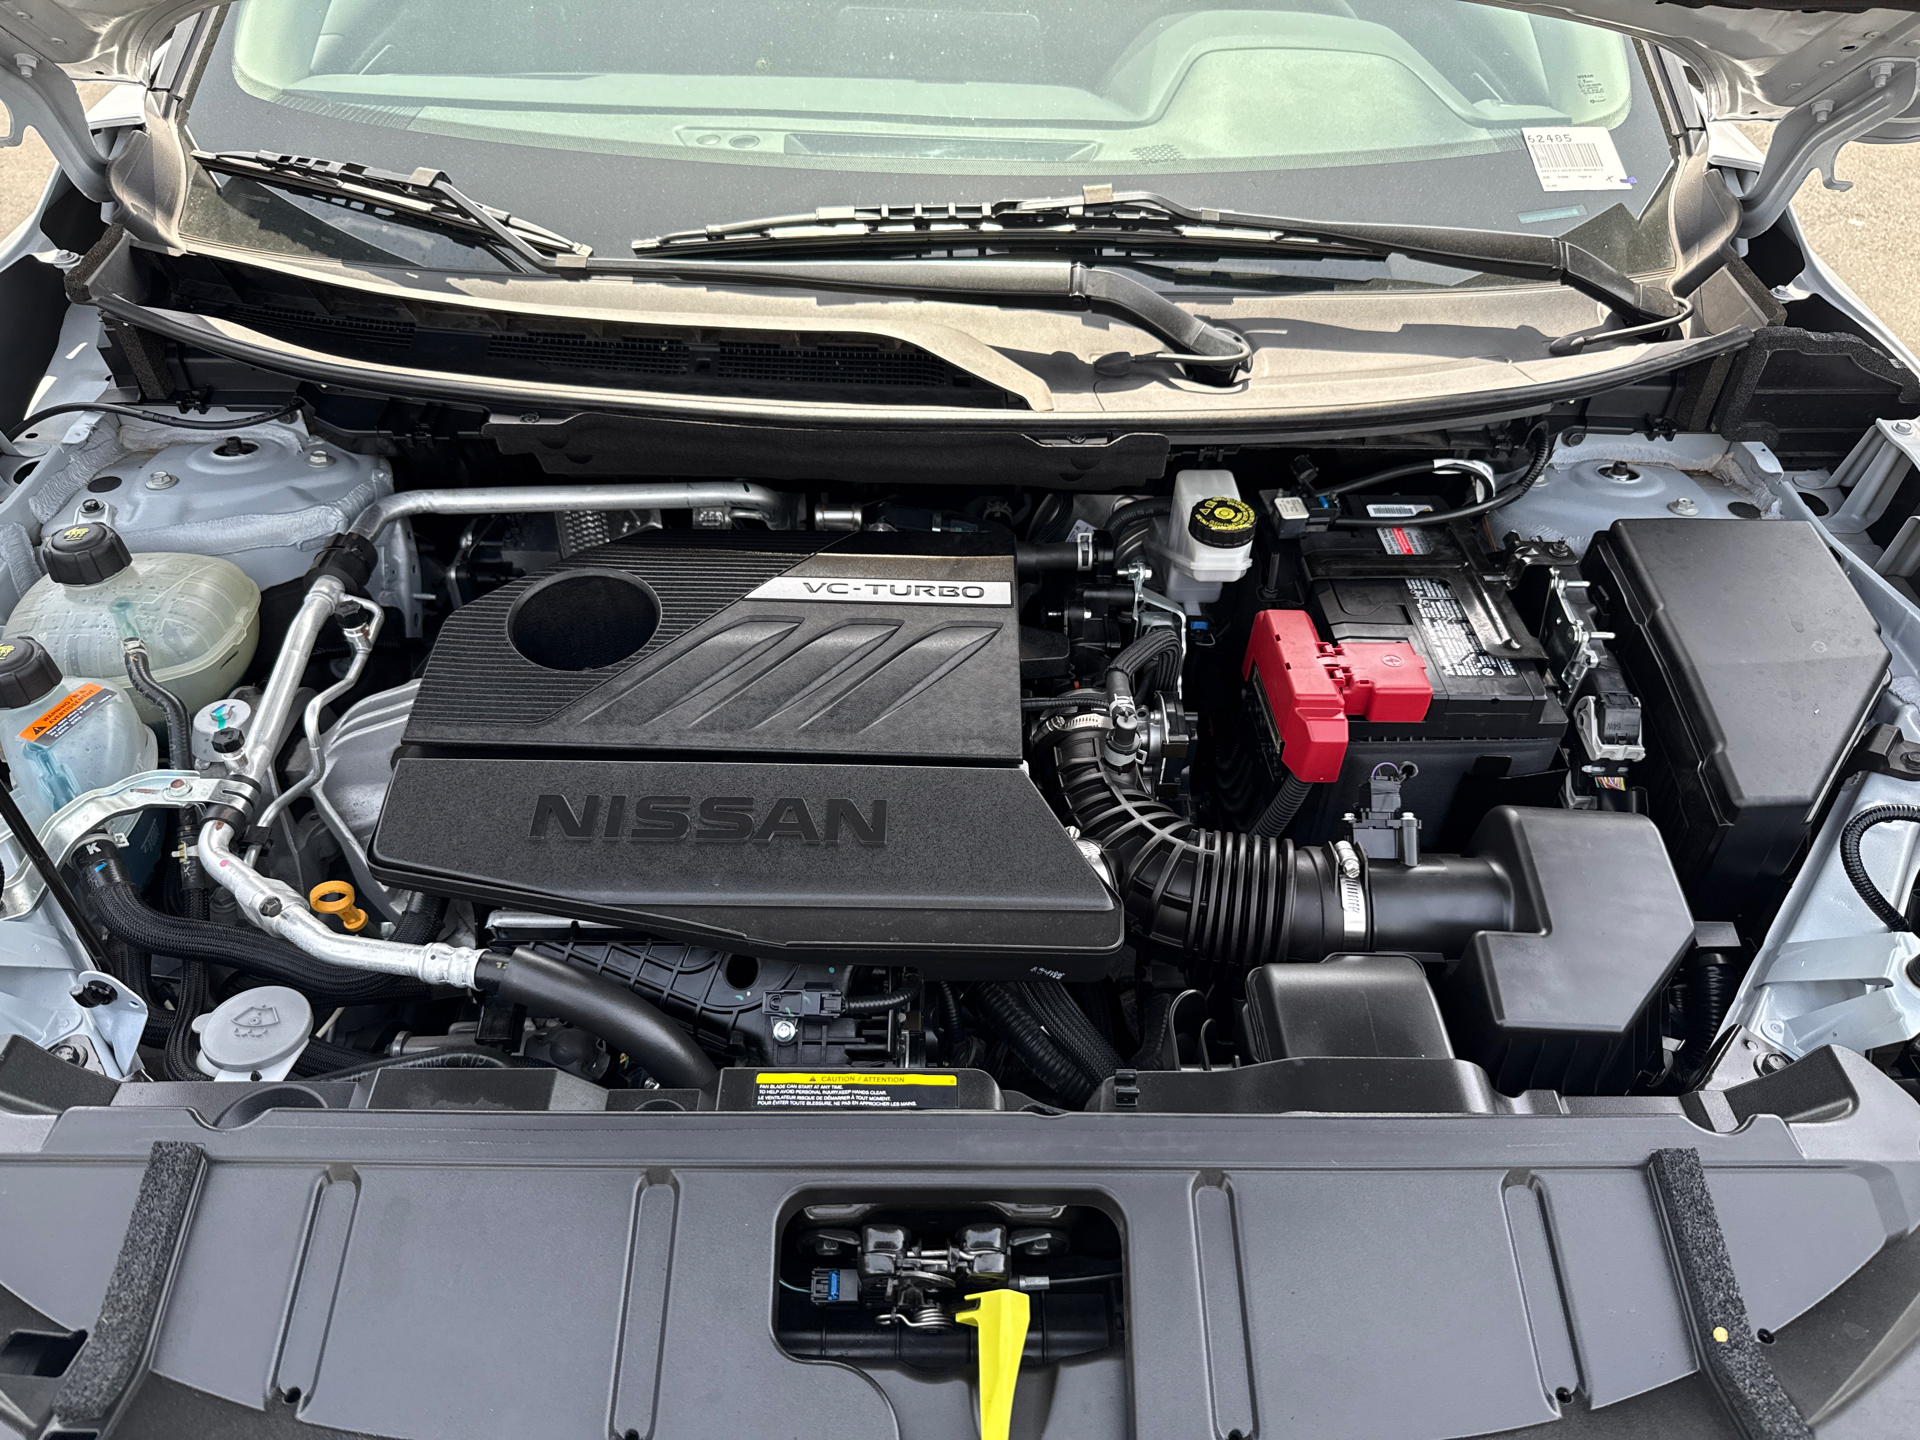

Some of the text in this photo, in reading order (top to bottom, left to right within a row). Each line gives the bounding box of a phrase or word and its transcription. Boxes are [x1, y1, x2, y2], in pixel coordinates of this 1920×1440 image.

[803, 582, 985, 599] VC-TURBO
[43, 699, 71, 722] WARNING
[528, 794, 888, 844] NISSAN
